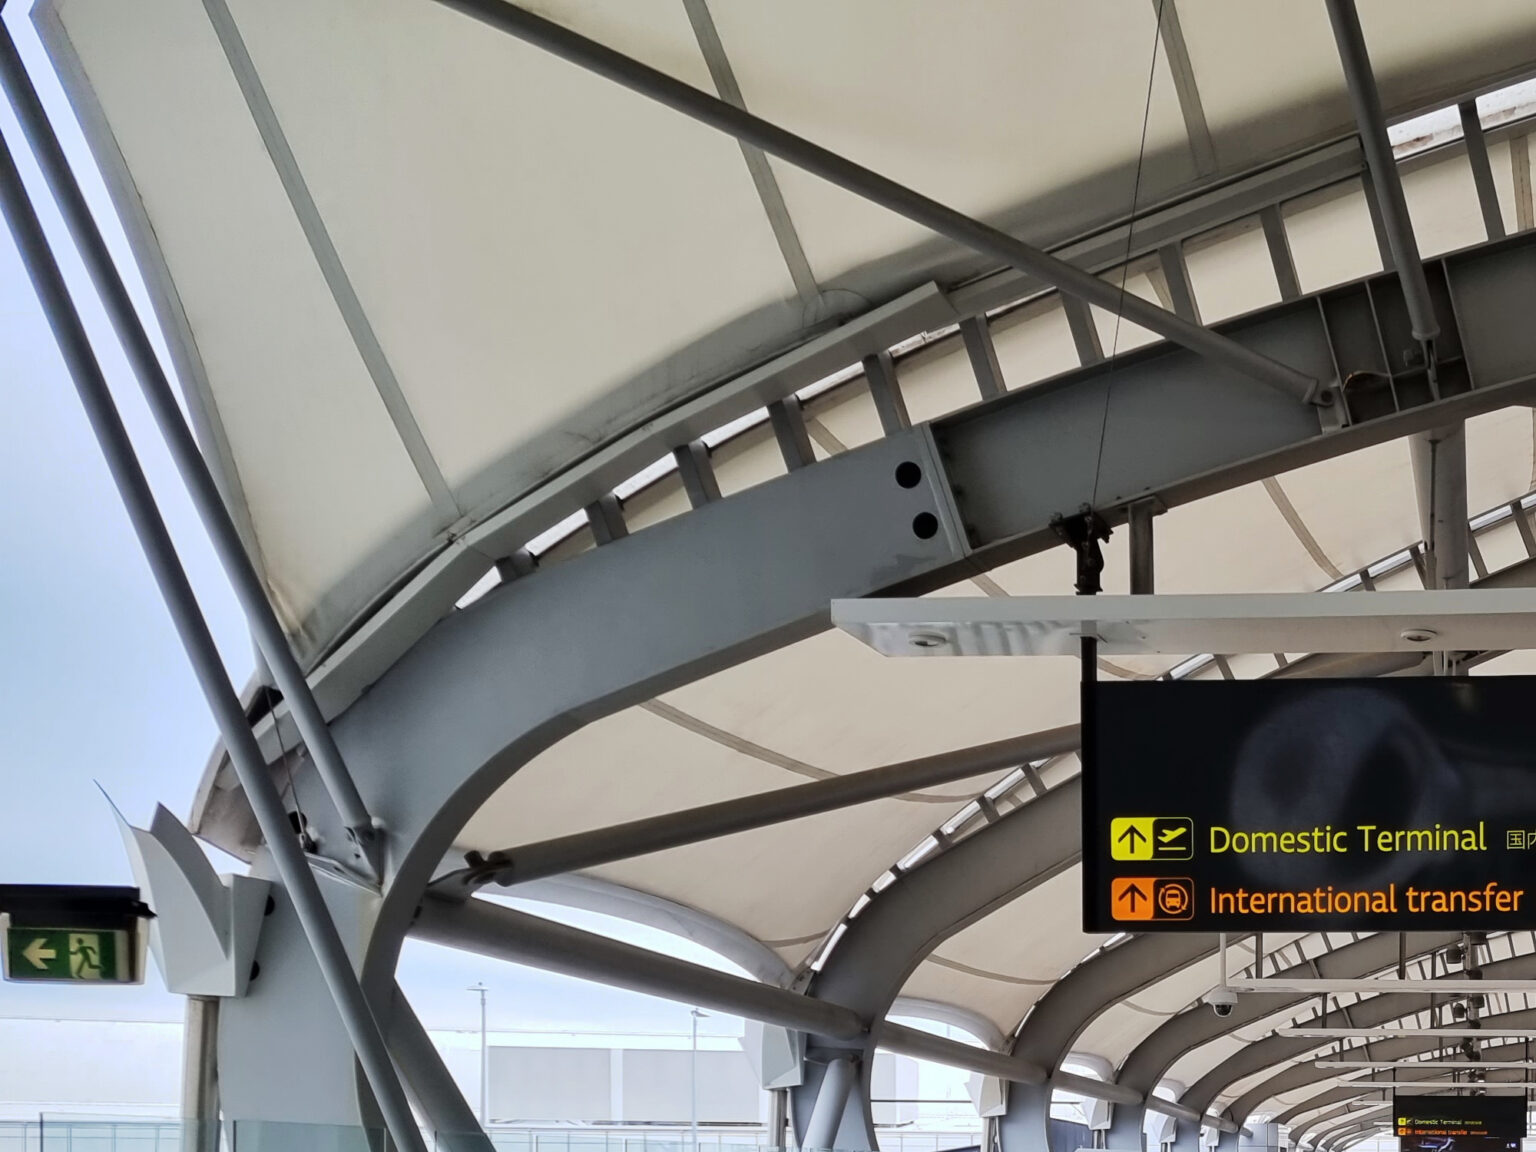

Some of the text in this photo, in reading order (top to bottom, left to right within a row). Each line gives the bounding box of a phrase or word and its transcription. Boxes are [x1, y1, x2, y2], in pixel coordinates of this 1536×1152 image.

[1210, 821, 1487, 853] Domestic Terminal
[1211, 882, 1524, 914] International transfer
